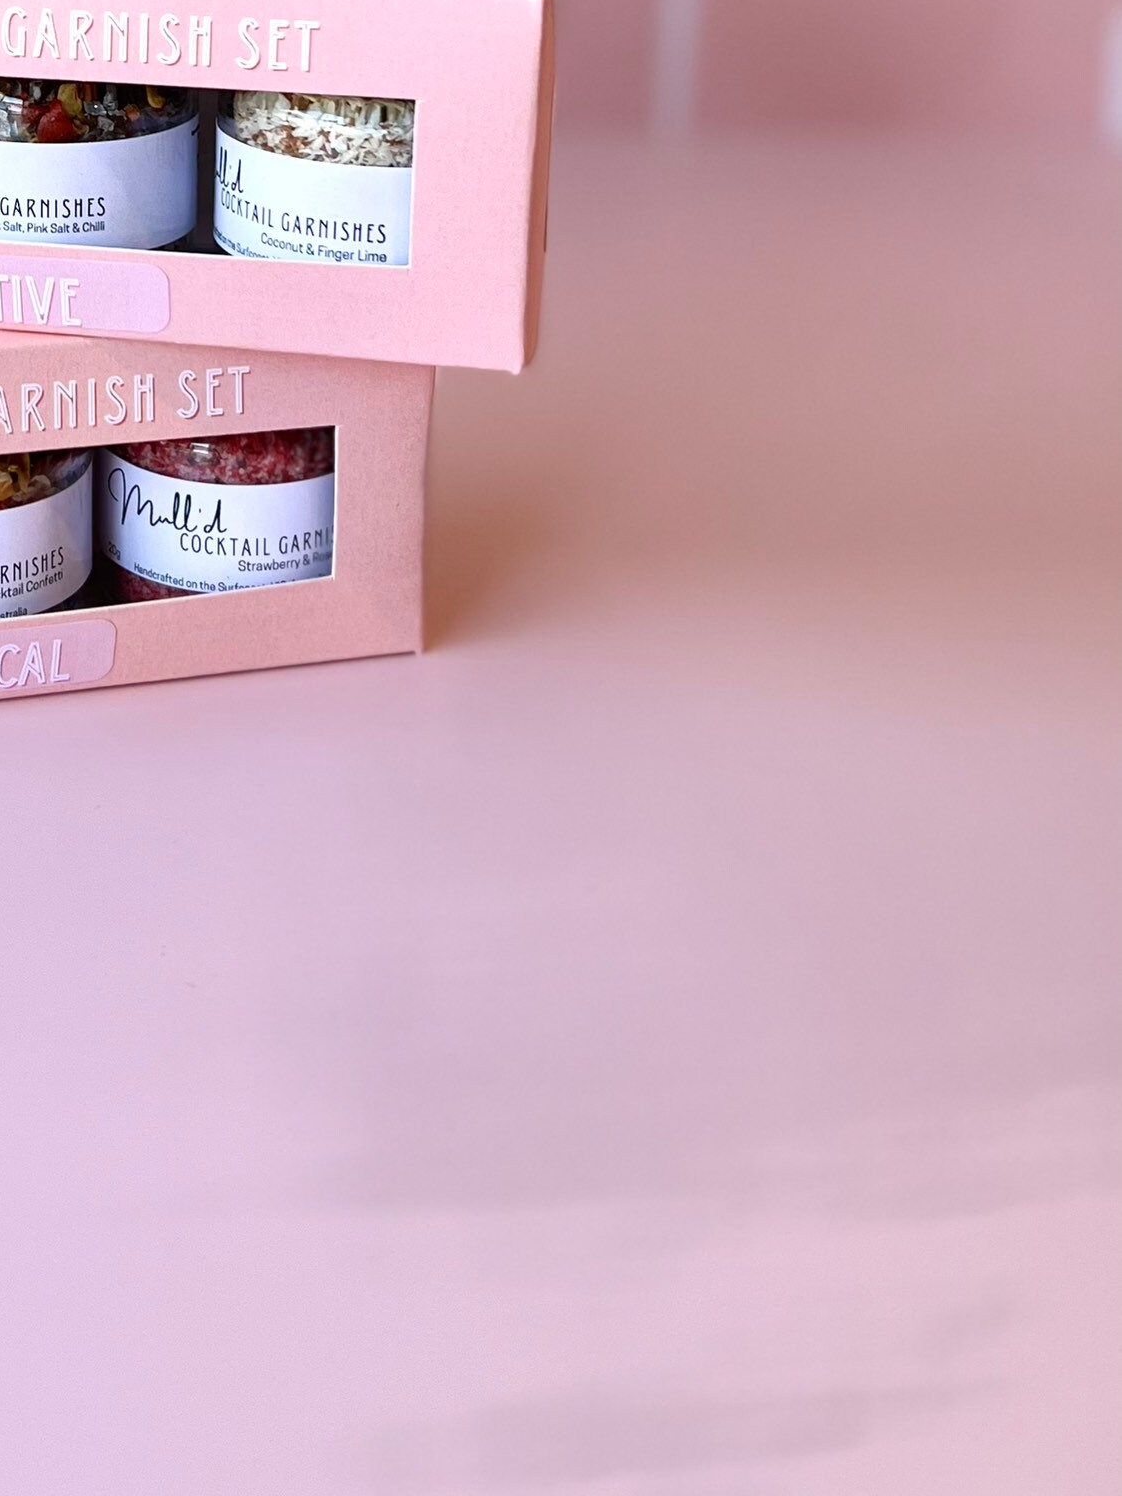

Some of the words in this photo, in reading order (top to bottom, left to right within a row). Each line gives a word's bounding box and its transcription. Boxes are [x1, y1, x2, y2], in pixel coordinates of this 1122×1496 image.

[0, 5, 213, 67] GARNISH
[235, 17, 321, 72] SET
[0, 197, 107, 219] GARNISHES
[221, 188, 274, 228] COCKTAIL
[281, 212, 387, 243] GARNISHES
[3, 221, 25, 234] Salt,
[27, 223, 48, 234] Pink
[50, 222, 70, 234] Salt
[72, 223, 81, 233] &
[82, 220, 106, 233] Chilli
[260, 232, 303, 254] Coconut
[306, 243, 315, 255] &
[318, 244, 354, 263] Finger
[358, 249, 387, 262] Lime
[177, 365, 252, 420] SET
[108, 467, 227, 534] Mull'd
[180, 533, 271, 557] COCKTAIL
[134, 562, 184, 587] Handcrafted
[186, 581, 198, 589] on
[200, 581, 216, 592] the
[238, 558, 301, 572] Strawberry
[302, 554, 311, 566] &
[26, 570, 64, 593] Confetti
